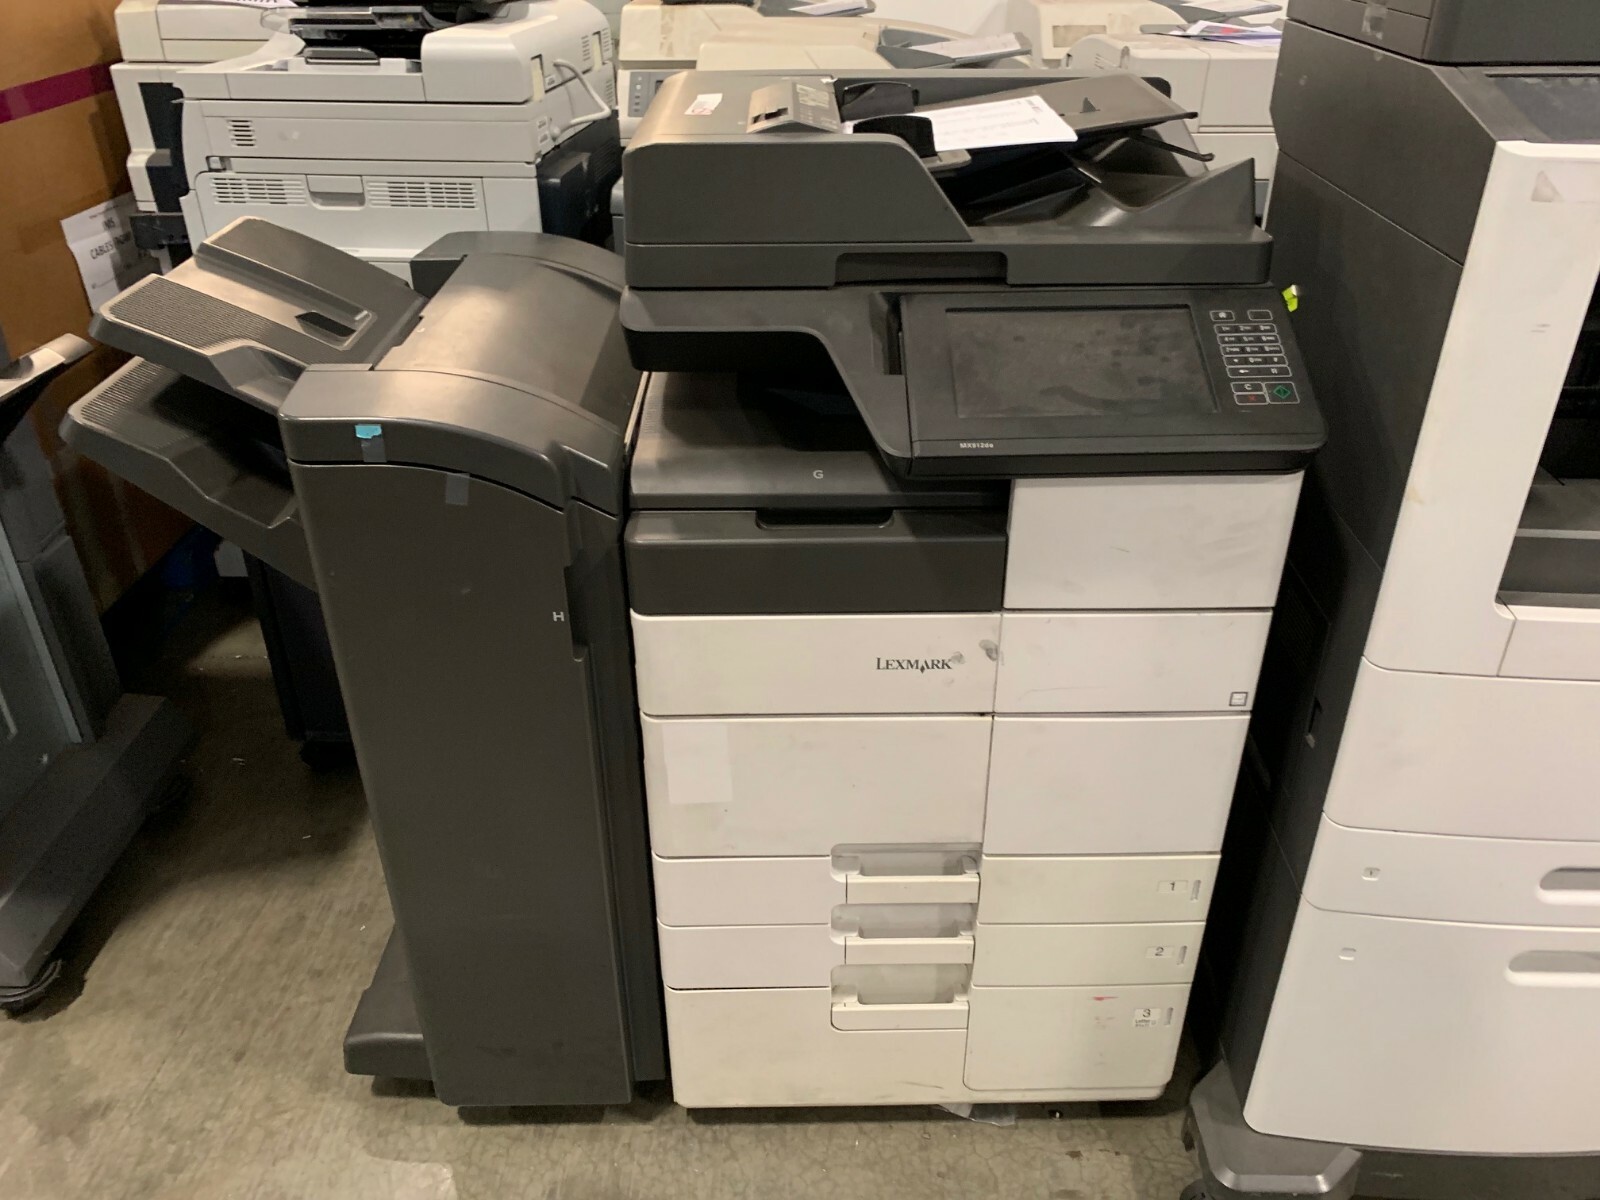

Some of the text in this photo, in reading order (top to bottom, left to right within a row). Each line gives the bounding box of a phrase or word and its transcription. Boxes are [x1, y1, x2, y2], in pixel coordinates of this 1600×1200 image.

[90, 241, 114, 260] CABLES
[812, 469, 824, 480] G
[552, 611, 565, 622] H
[876, 657, 952, 674] LEXMARK
[1169, 881, 1176, 892] 1
[1154, 946, 1165, 957] 2
[1142, 1008, 1151, 1018] 3
